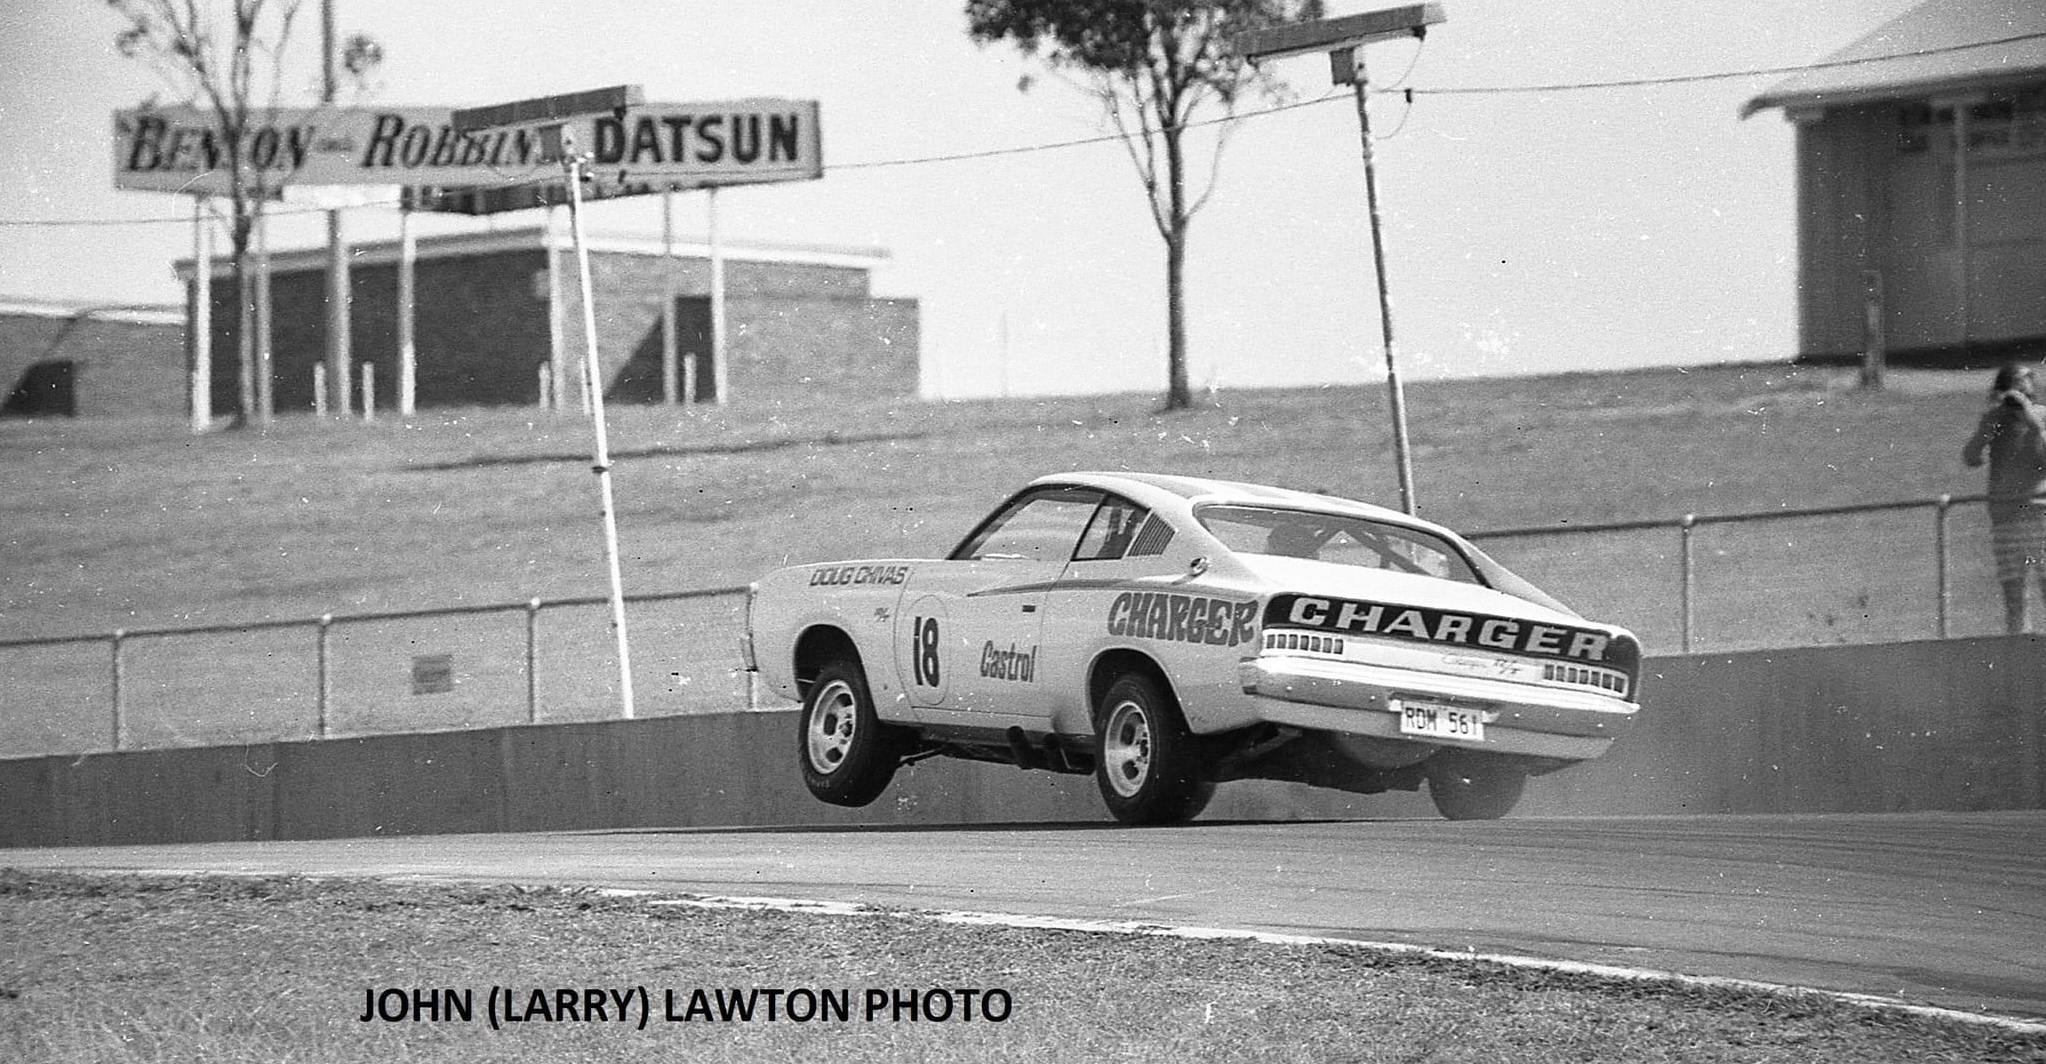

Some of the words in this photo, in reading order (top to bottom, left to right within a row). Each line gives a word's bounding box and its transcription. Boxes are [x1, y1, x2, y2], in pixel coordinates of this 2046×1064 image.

[128, 114, 316, 171] BENON
[361, 113, 560, 168] ROBBIN
[594, 113, 798, 165] DATSUN
[809, 566, 855, 587] DOUG
[853, 565, 909, 585] CHIVAS
[1107, 592, 1259, 647] CHARGER
[1289, 597, 1609, 661] CHARGER
[913, 616, 940, 688] 18
[980, 639, 1038, 683] Castrol
